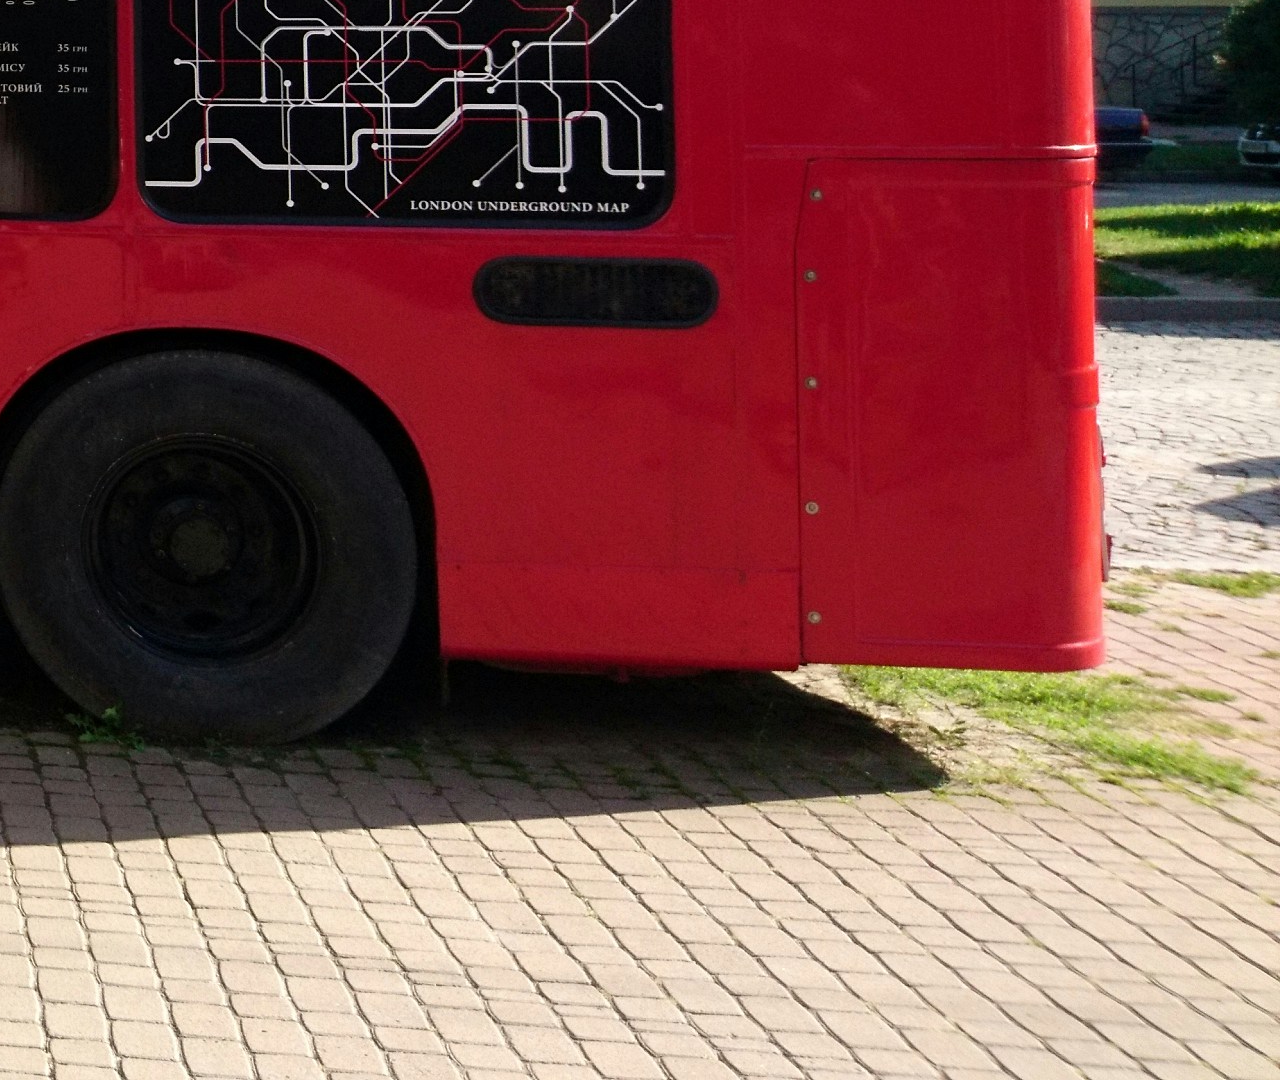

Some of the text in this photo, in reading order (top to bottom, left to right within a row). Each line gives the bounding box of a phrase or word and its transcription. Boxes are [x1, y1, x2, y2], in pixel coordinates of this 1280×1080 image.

[57, 44, 69, 52] 35
[57, 64, 70, 72] 35
[58, 84, 70, 92] 25
[410, 200, 630, 213] LONDON UNDERGROUND MAP
